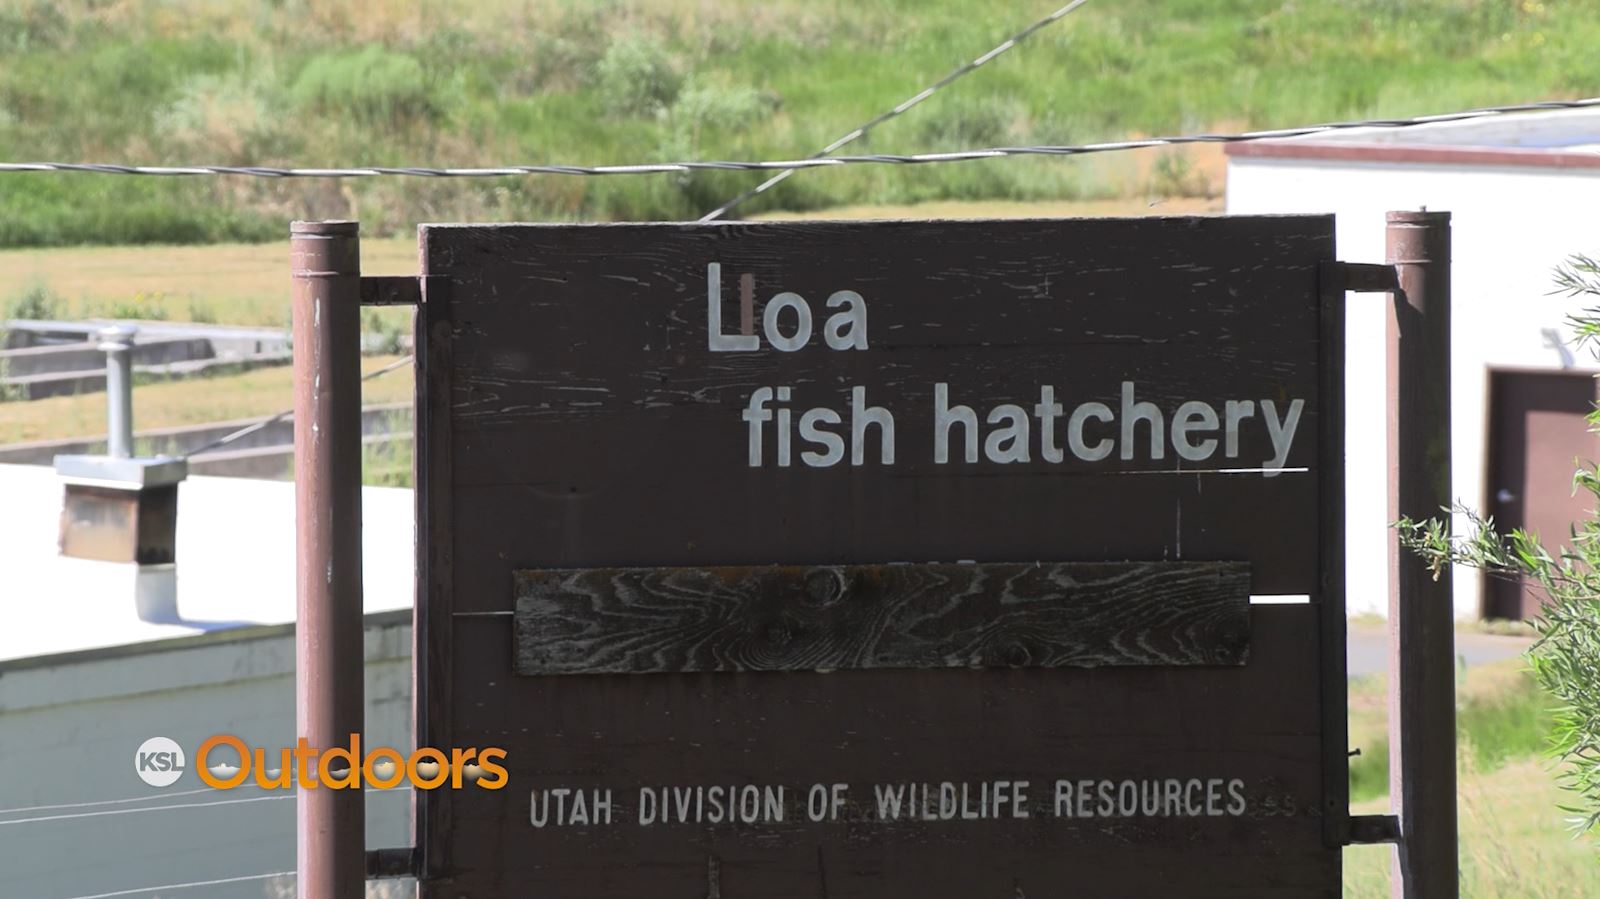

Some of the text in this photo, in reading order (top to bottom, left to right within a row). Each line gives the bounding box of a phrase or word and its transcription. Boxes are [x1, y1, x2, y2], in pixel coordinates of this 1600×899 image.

[707, 261, 869, 352] Loa
[742, 380, 1305, 478] fish hatchery
[530, 788, 612, 828] UTAH
[638, 784, 785, 825] DIVISION
[807, 783, 849, 822] OF
[874, 780, 1030, 821] WILDLIFE
[1054, 778, 1247, 818] RESOURCES
